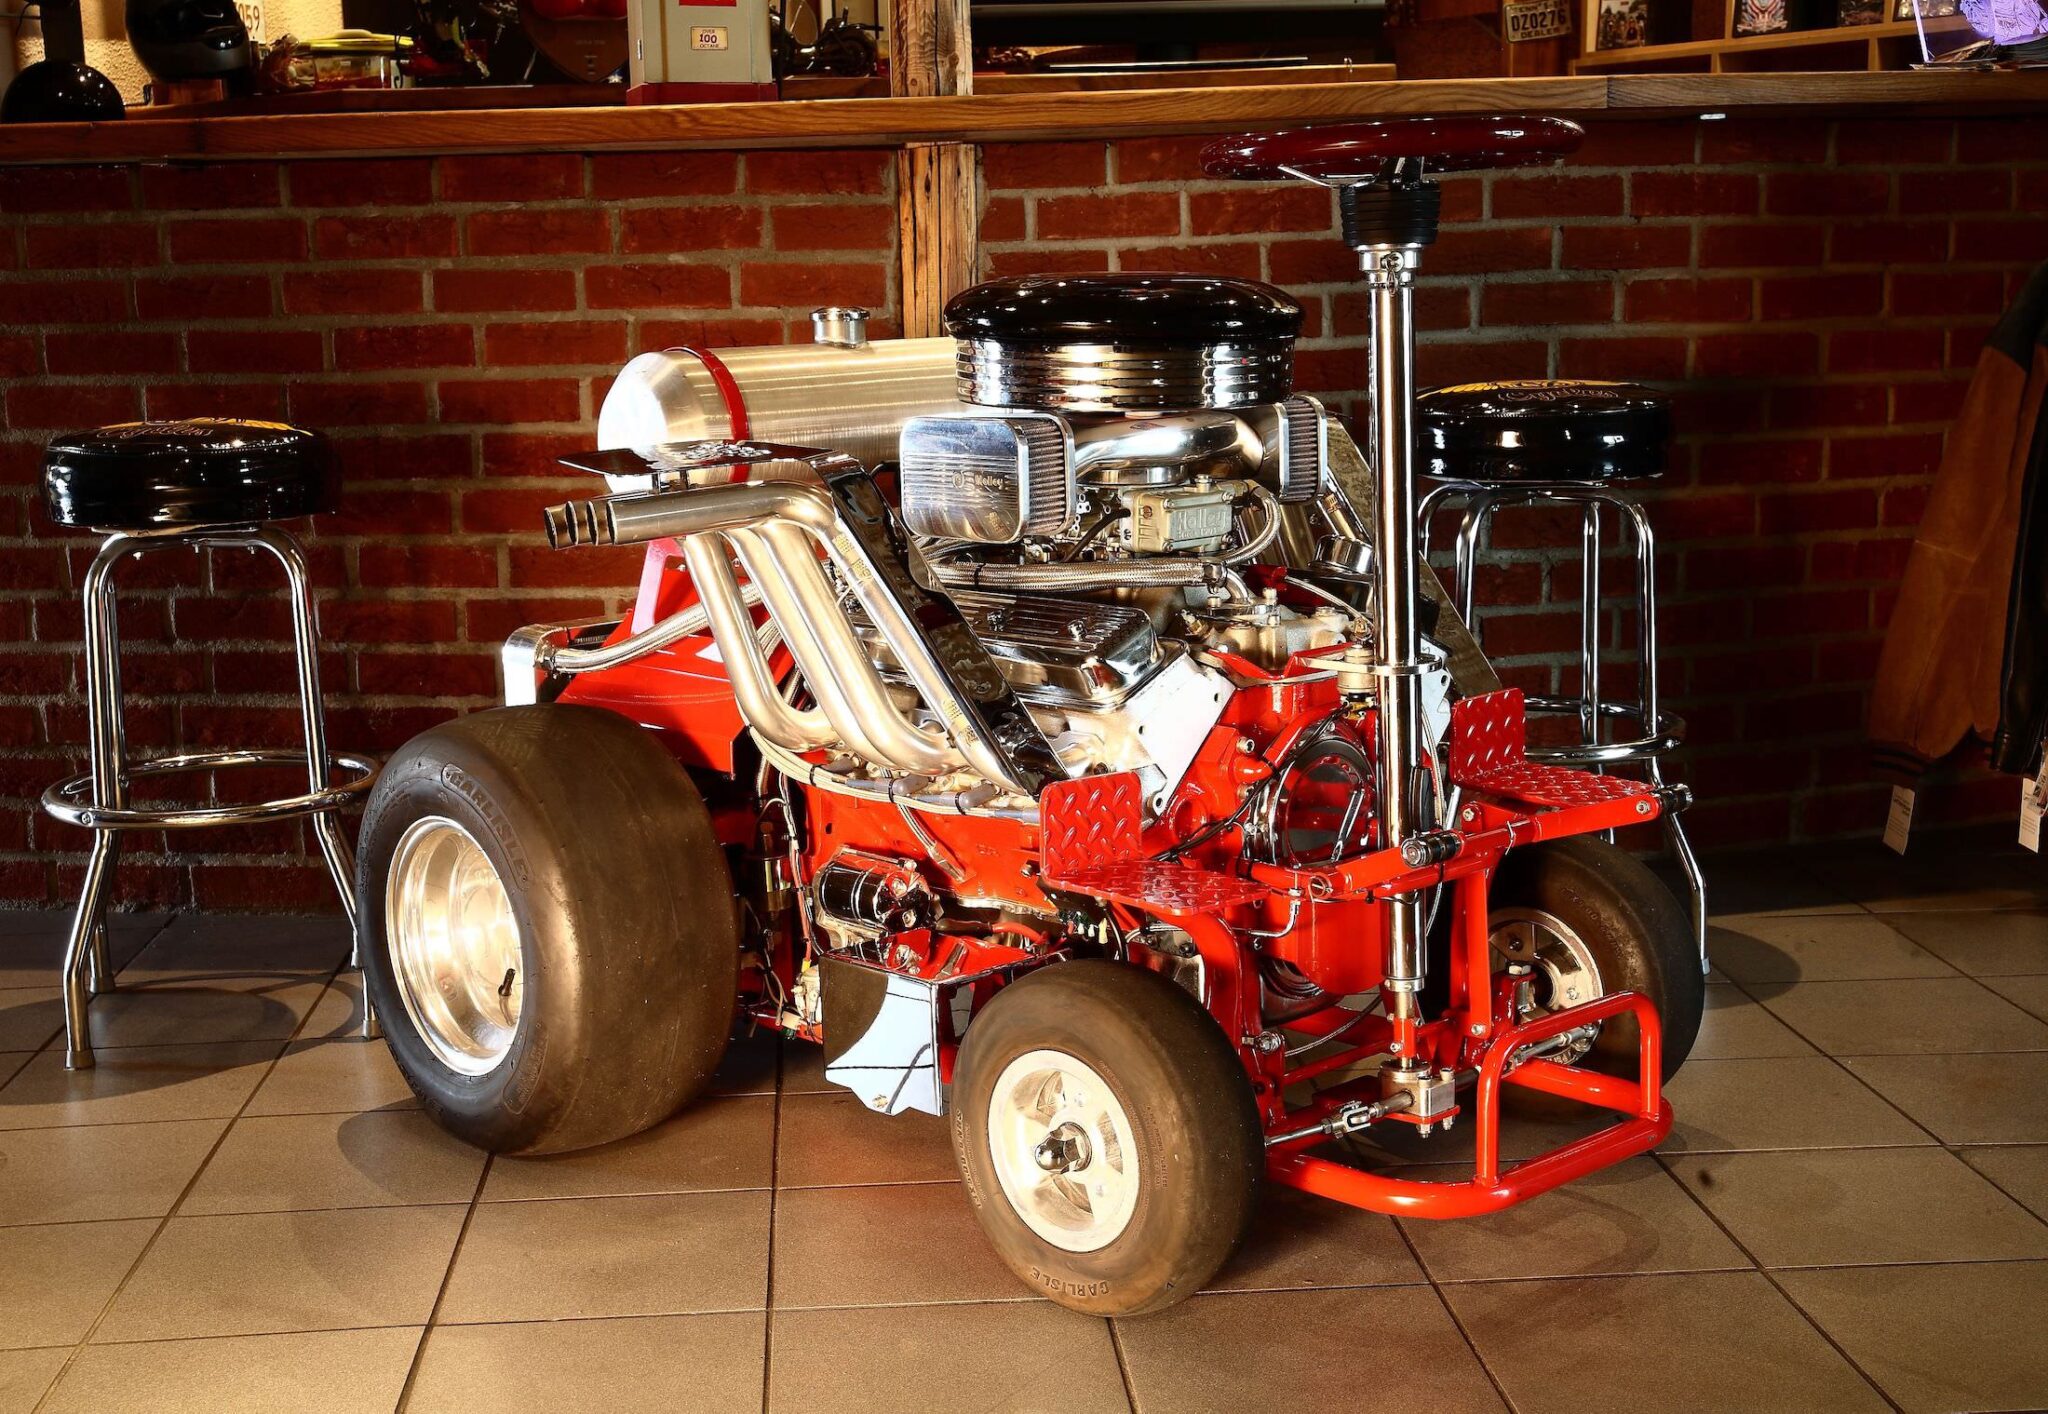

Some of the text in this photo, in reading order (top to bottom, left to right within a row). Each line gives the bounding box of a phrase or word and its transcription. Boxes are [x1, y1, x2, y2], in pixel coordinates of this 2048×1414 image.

[699, 34, 718, 44] 100
[448, 768, 529, 877] CARLISLE
[1030, 1266, 1110, 1297] CARLISLE
